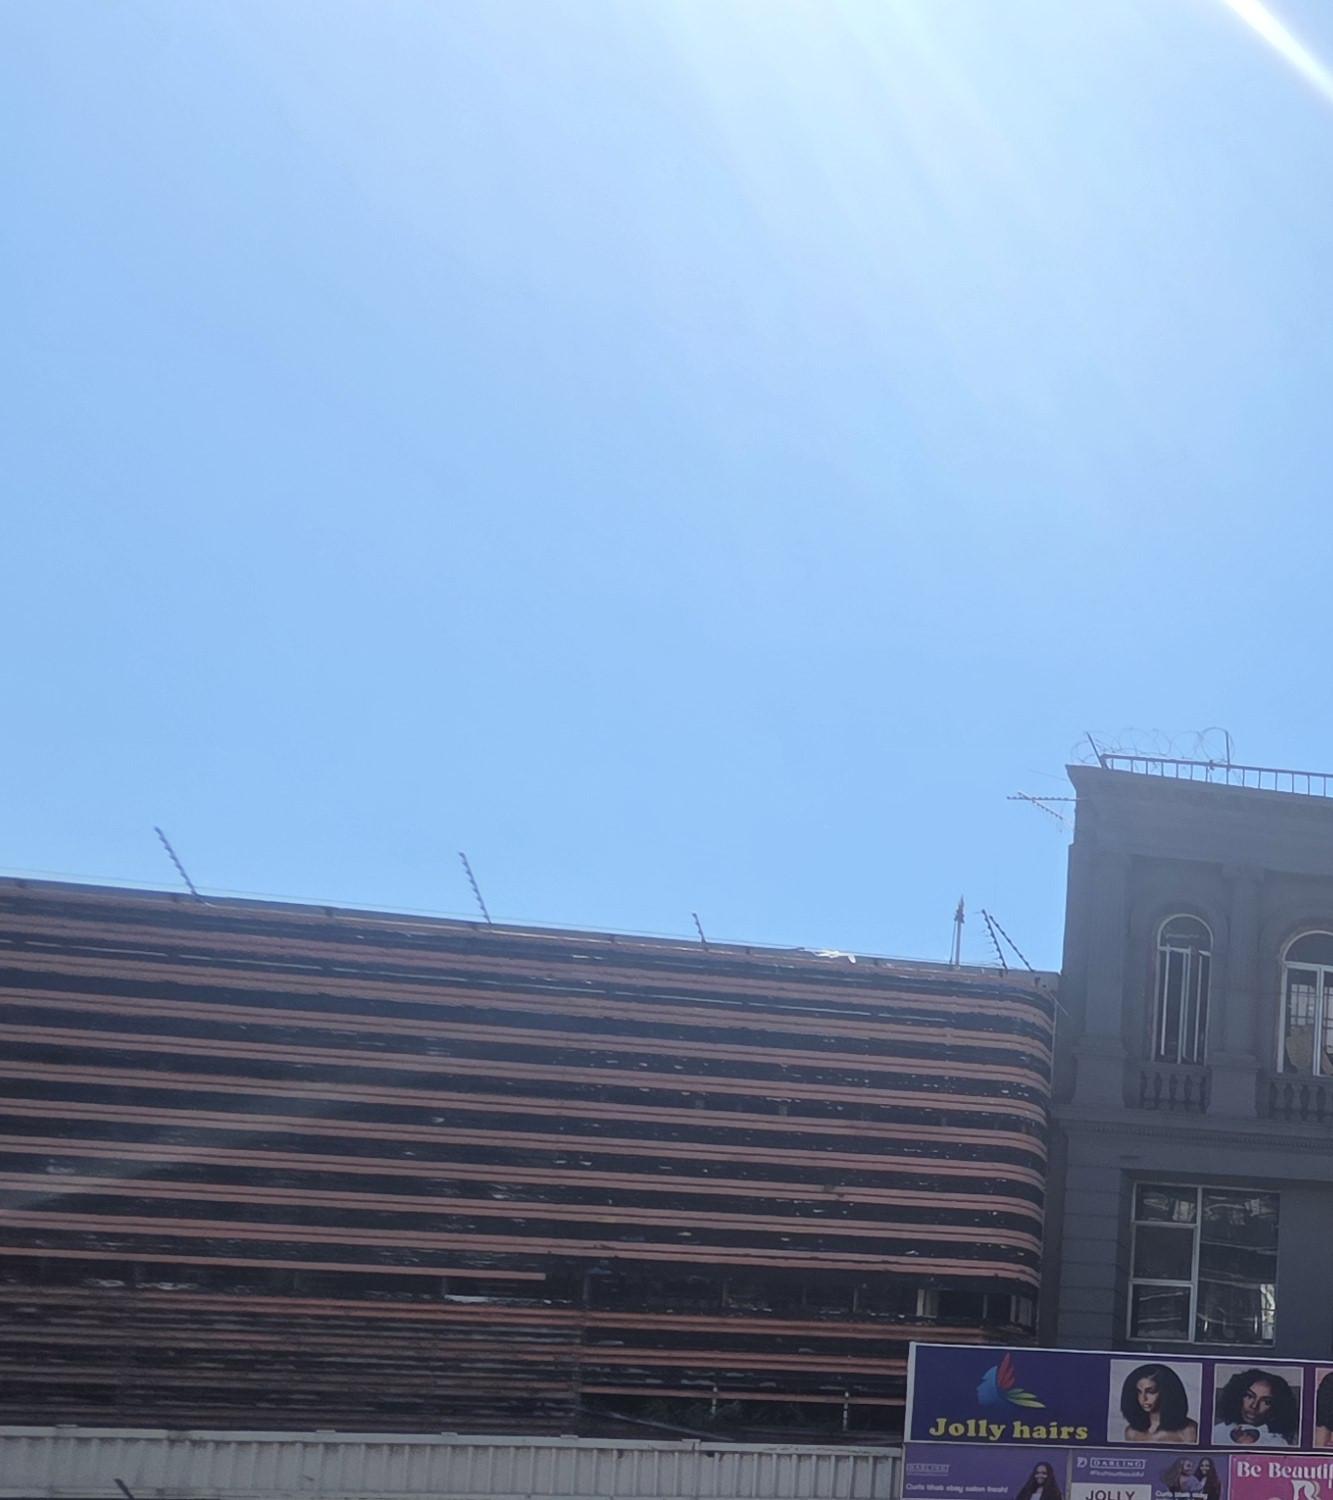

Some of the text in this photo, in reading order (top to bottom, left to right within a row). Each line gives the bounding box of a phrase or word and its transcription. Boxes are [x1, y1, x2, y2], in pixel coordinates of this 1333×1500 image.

[929, 1418, 1089, 1441] Jolly hairs
[1093, 1460, 1143, 1468] DARLING
[1237, 1461, 1262, 1478] Be
